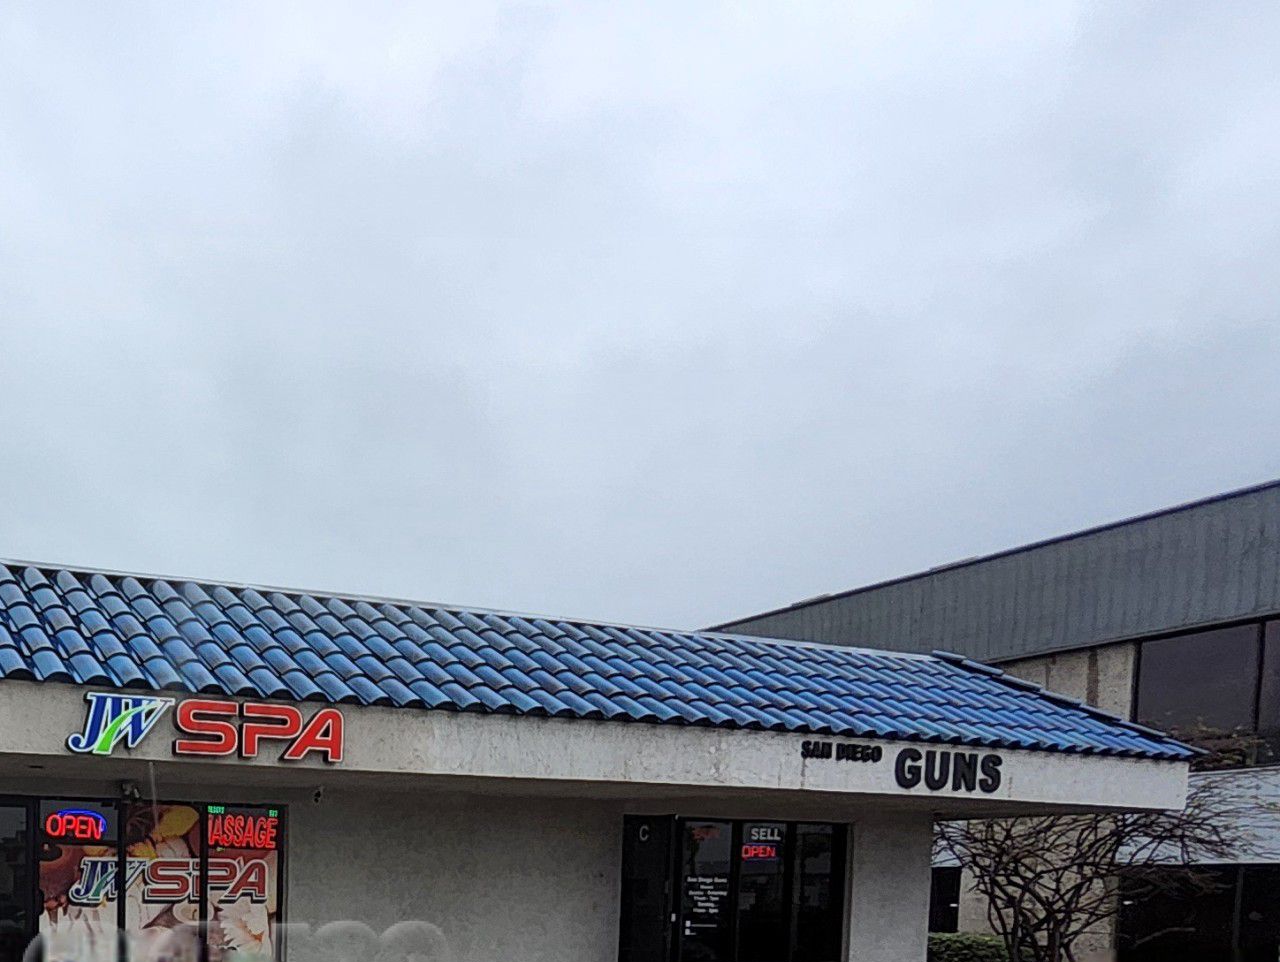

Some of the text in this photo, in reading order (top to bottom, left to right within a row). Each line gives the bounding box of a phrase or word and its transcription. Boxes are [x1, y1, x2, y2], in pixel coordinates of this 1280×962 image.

[69, 692, 345, 763] JW SPA
[801, 740, 883, 763] SAN DIEGO
[894, 747, 1004, 793] GUNS
[46, 813, 104, 842] OPEN
[750, 827, 783, 841] SELL
[741, 844, 778, 859] OPEN
[143, 858, 268, 904] SPA
